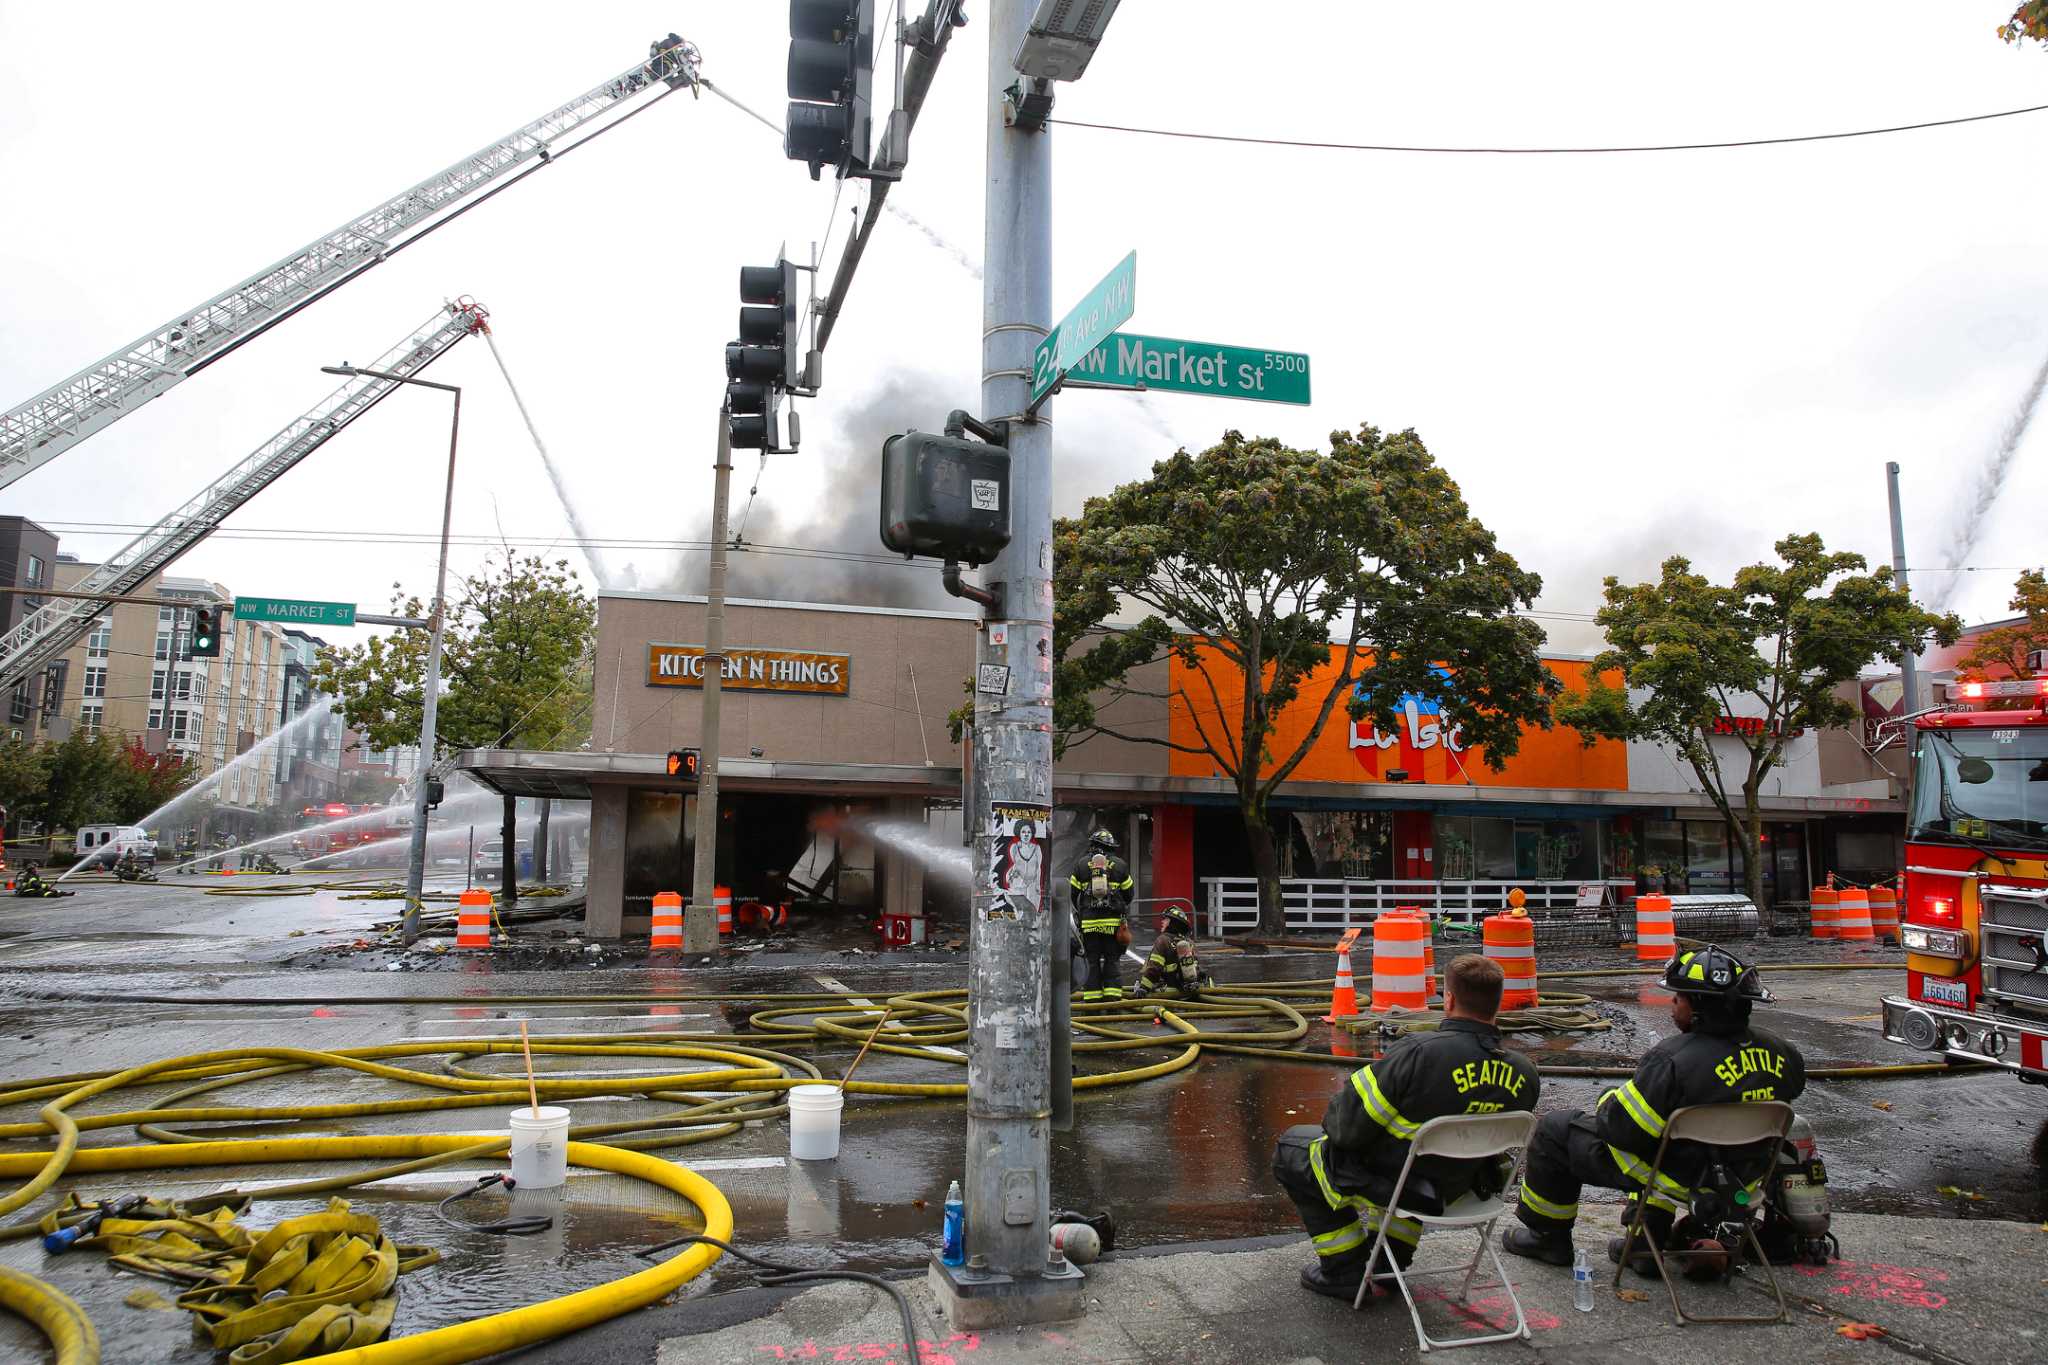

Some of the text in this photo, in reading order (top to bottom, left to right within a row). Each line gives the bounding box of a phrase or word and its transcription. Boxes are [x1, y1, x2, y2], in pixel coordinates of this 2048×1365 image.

[1074, 307, 1099, 347] Ave
[1104, 271, 1130, 321] NW
[1118, 338, 1228, 388] Market
[1238, 363, 1265, 392] St
[1264, 353, 1306, 373] 5500
[240, 603, 350, 618] NW MARKET ST
[659, 654, 742, 679] KITCEN
[769, 659, 840, 684] THINGS
[1713, 970, 1729, 982] 27
[1452, 1059, 1526, 1098] SEATTLE
[1715, 1048, 1785, 1087] SEATTLE
